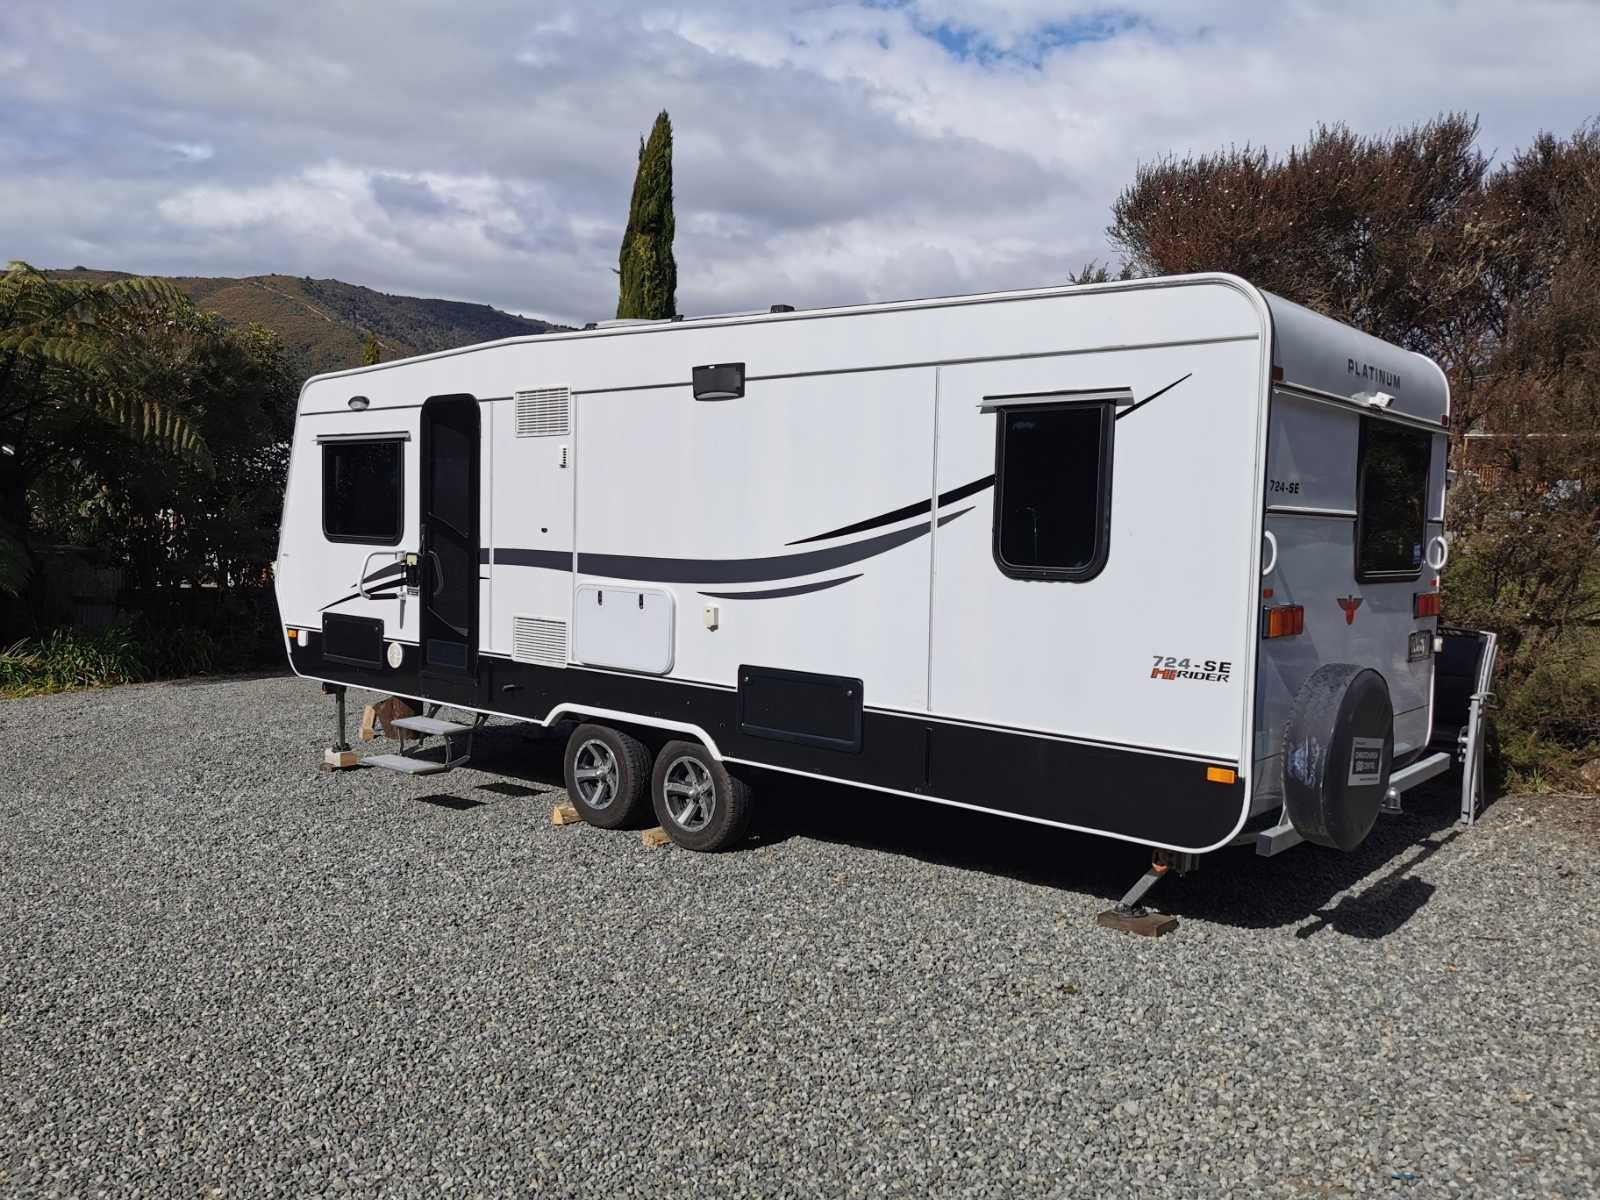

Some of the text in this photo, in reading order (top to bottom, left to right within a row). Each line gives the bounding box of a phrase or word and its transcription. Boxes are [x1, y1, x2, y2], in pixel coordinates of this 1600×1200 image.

[1347, 358, 1401, 389] PLATINUM
[1269, 479, 1300, 495] 724-SE
[1153, 656, 1231, 673] 724-SE
